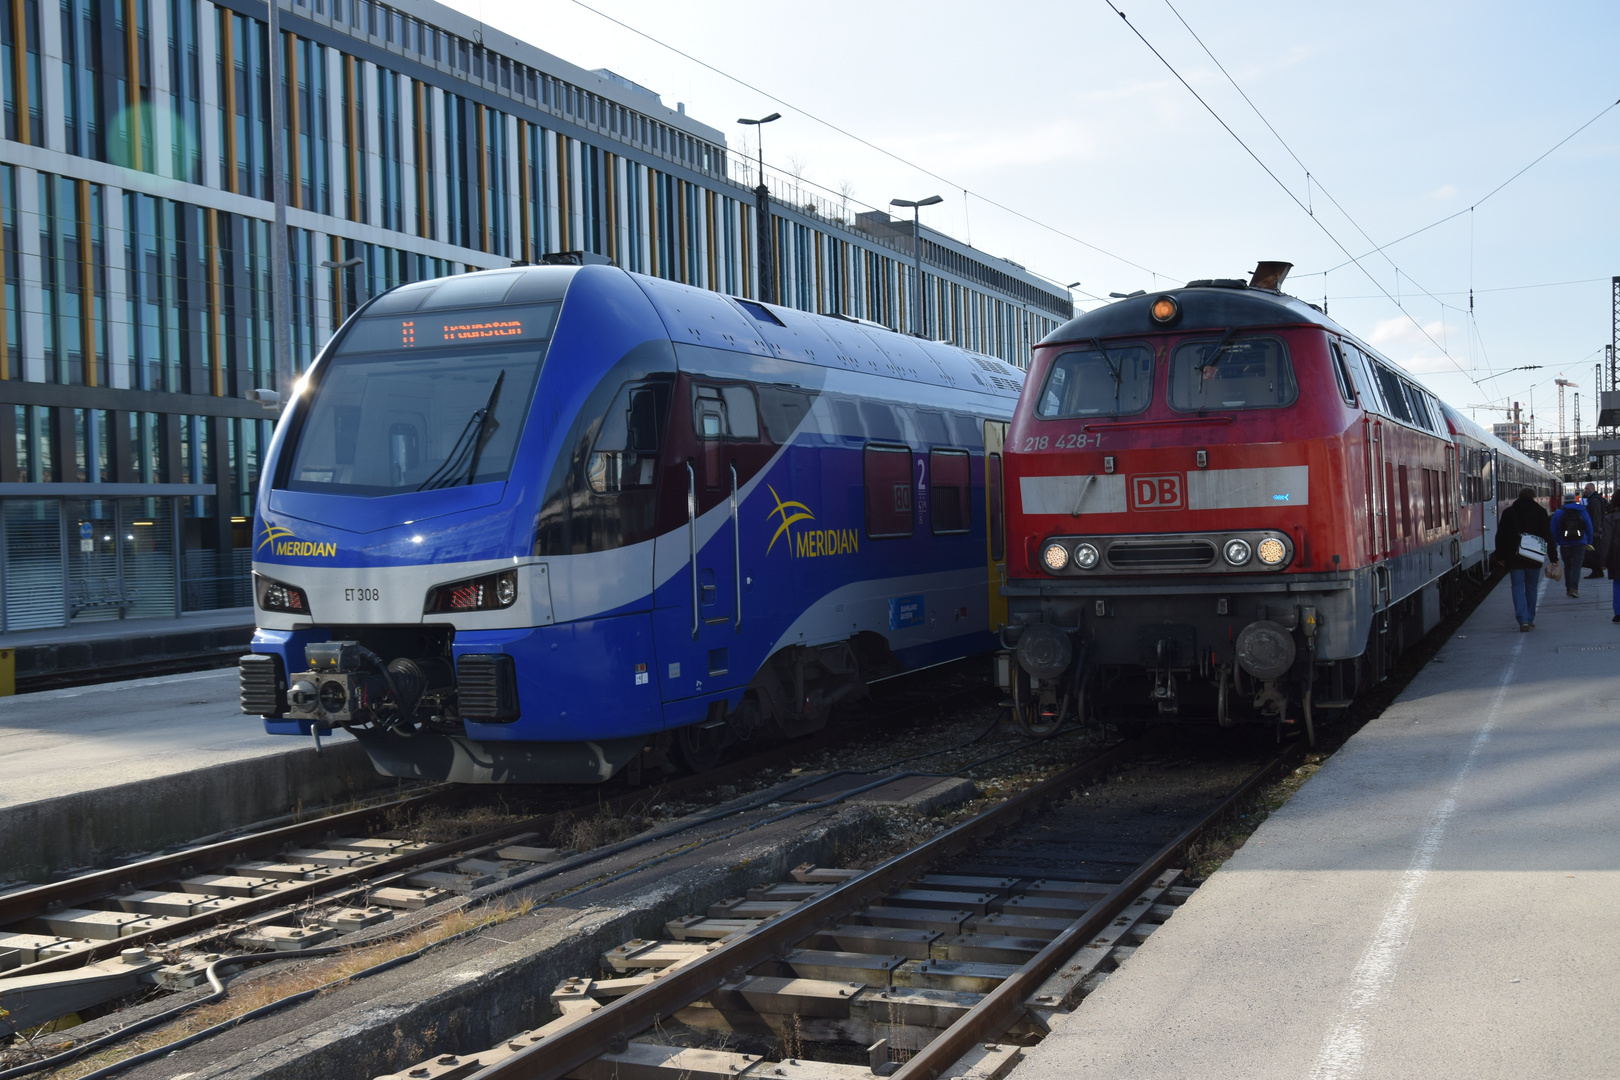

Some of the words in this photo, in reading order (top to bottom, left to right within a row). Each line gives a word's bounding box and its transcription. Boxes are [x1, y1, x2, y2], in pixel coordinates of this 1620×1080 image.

[1024, 435, 1049, 452] 218
[1055, 433, 1101, 448] 428-1
[917, 459, 926, 490] 2
[1137, 479, 1178, 505] DB
[276, 541, 337, 557] MERIDIAN
[797, 528, 859, 558] MERIDIAN
[345, 588, 355, 601] ET
[357, 588, 379, 601] 308
